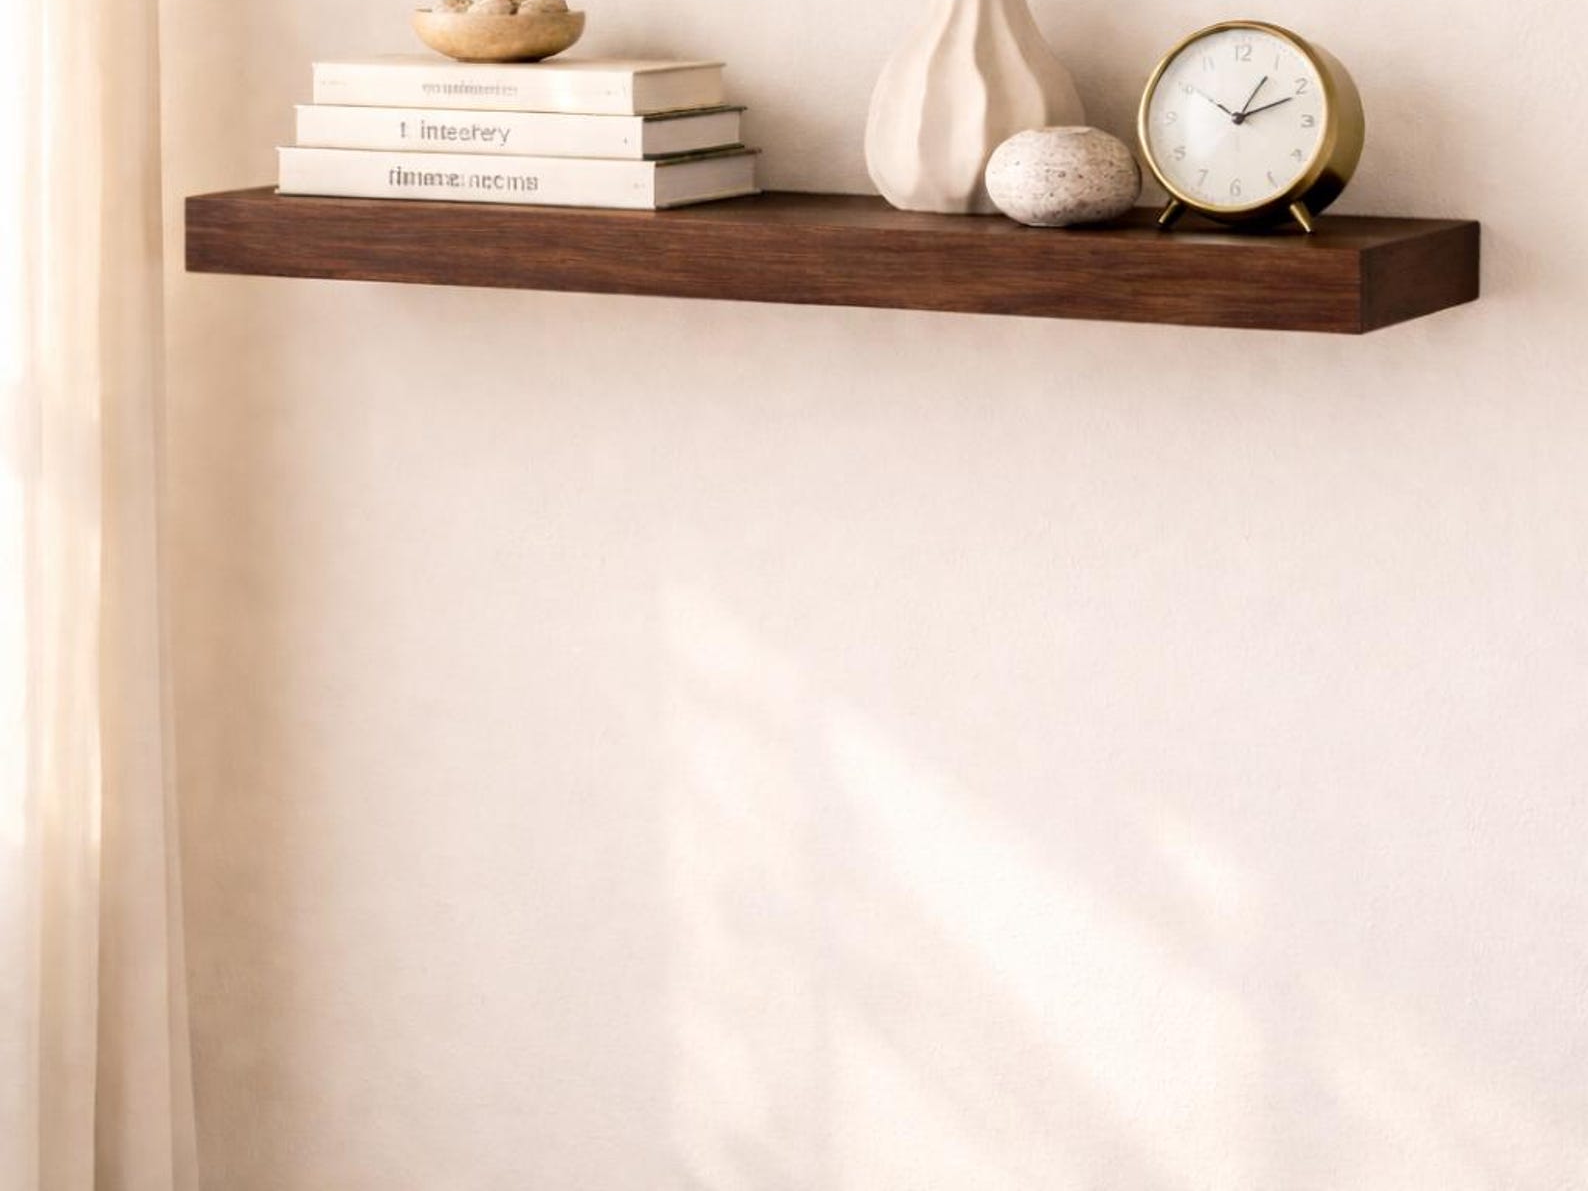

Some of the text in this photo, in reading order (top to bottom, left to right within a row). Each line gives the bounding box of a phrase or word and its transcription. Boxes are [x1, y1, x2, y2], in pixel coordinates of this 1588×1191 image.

[1234, 44, 1253, 62] 12
[1294, 77, 1309, 96] 2
[1301, 113, 1315, 128] 3
[1198, 168, 1209, 187] 7
[1229, 177, 1242, 196] 6
